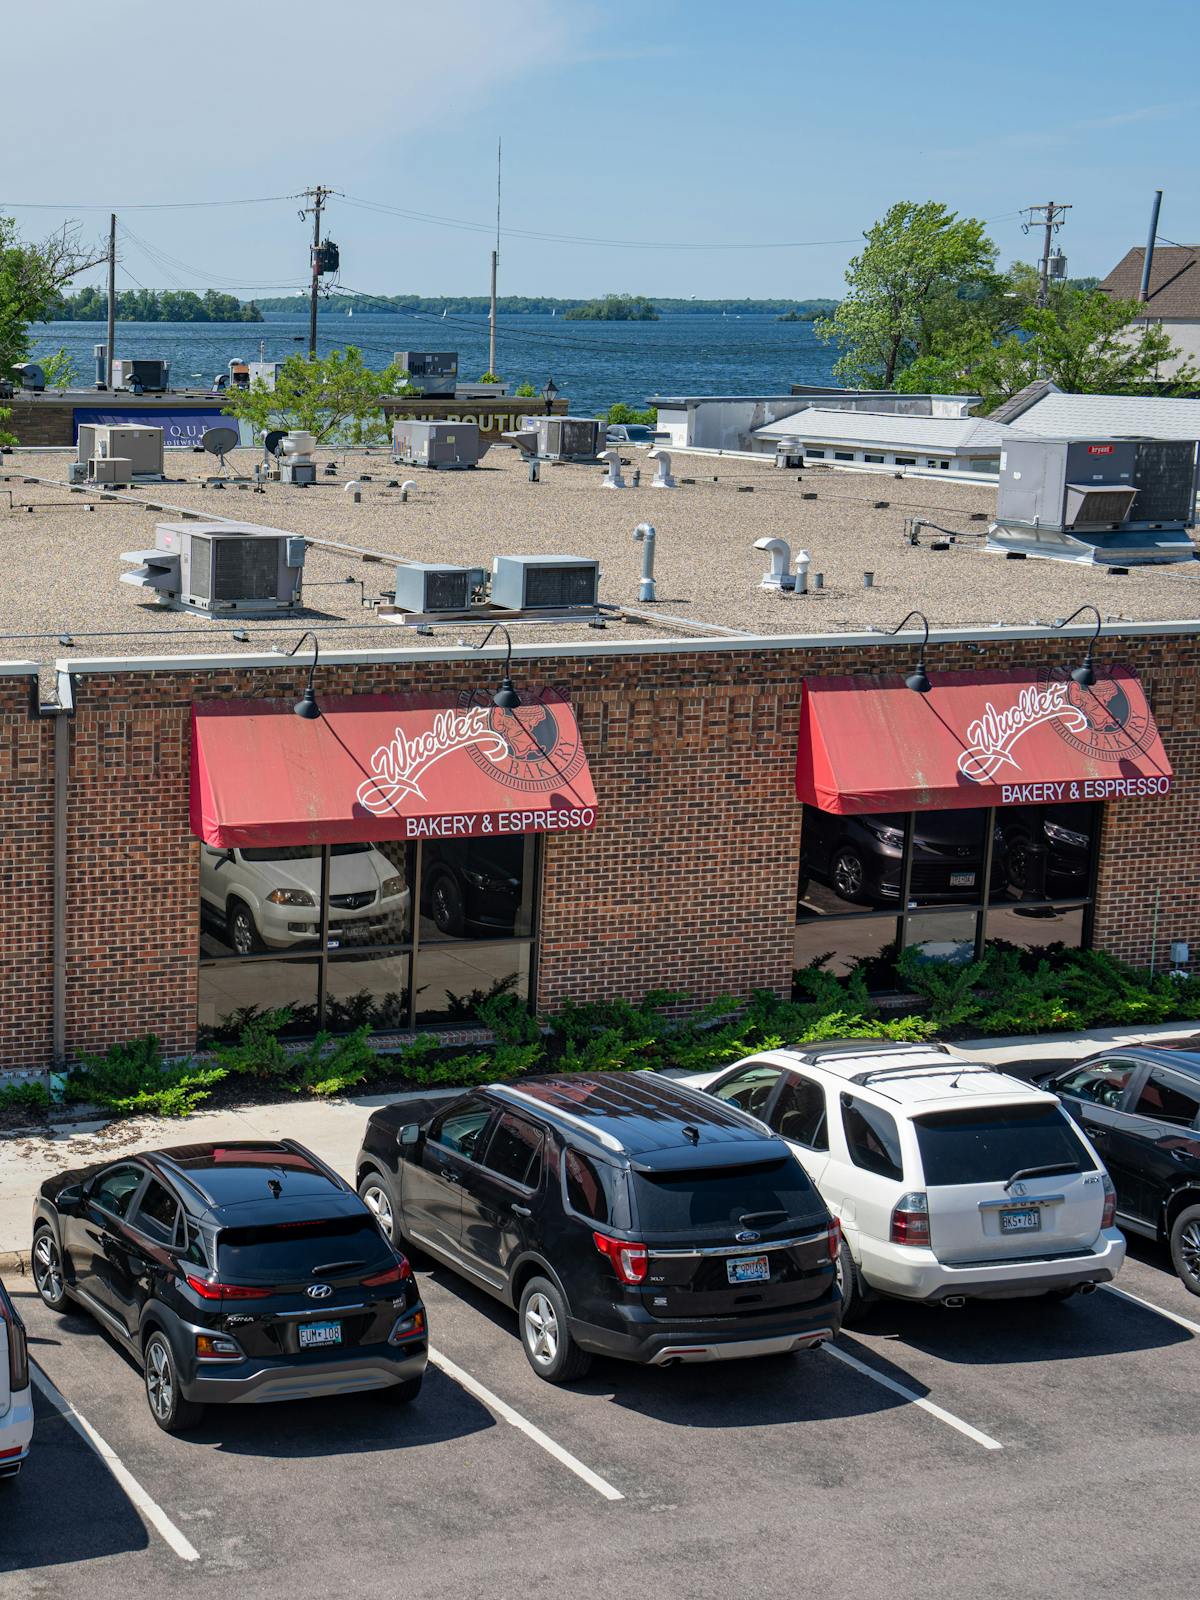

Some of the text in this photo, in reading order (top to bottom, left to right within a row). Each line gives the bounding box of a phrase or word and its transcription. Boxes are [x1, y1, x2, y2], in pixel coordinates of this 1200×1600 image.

[967, 683, 1068, 754] Wuollet
[1090, 710, 1146, 750] BAKRY
[371, 706, 490, 783] Wuollet
[508, 736, 574, 779] BAKRY
[1002, 776, 1170, 803] BAKERY & ESPRESSO
[406, 808, 595, 837] BAKERY & ESPRESSO
[300, 1327, 340, 1342] EUM 108
